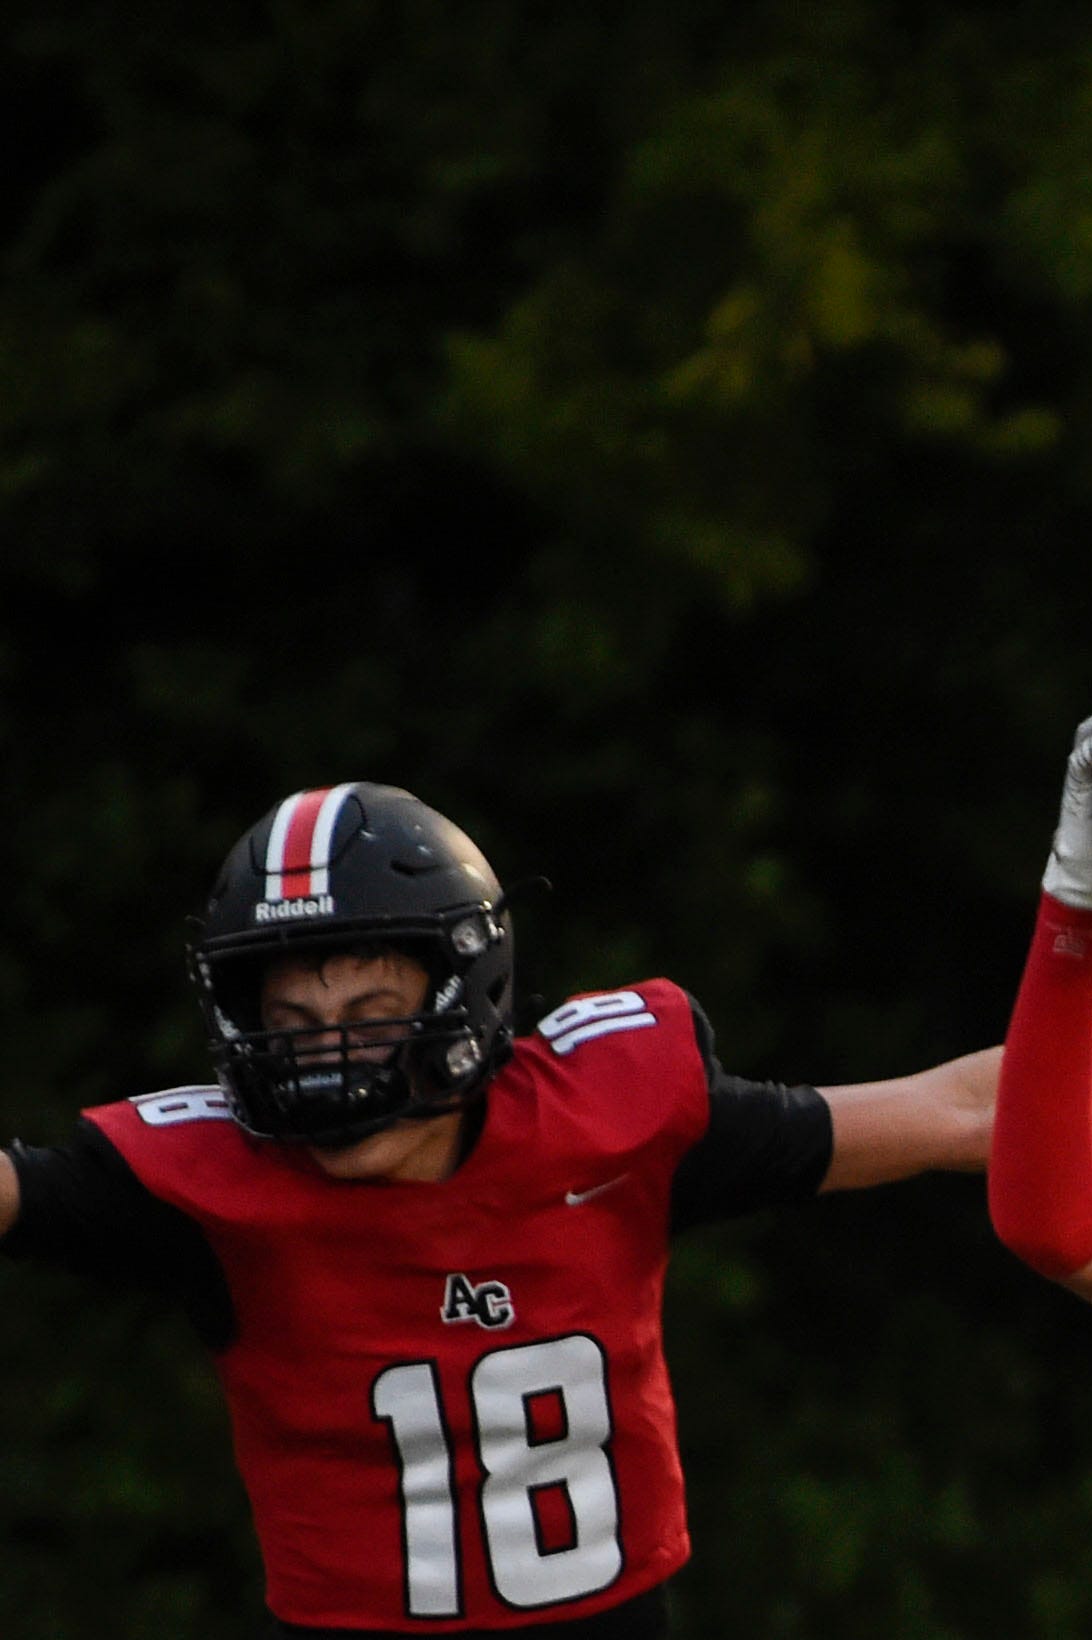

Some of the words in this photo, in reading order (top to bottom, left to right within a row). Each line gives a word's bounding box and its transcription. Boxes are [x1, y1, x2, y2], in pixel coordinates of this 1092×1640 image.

[256, 896, 334, 921] Riddell
[440, 1273, 515, 1330] AC
[371, 1331, 624, 1620] 18
